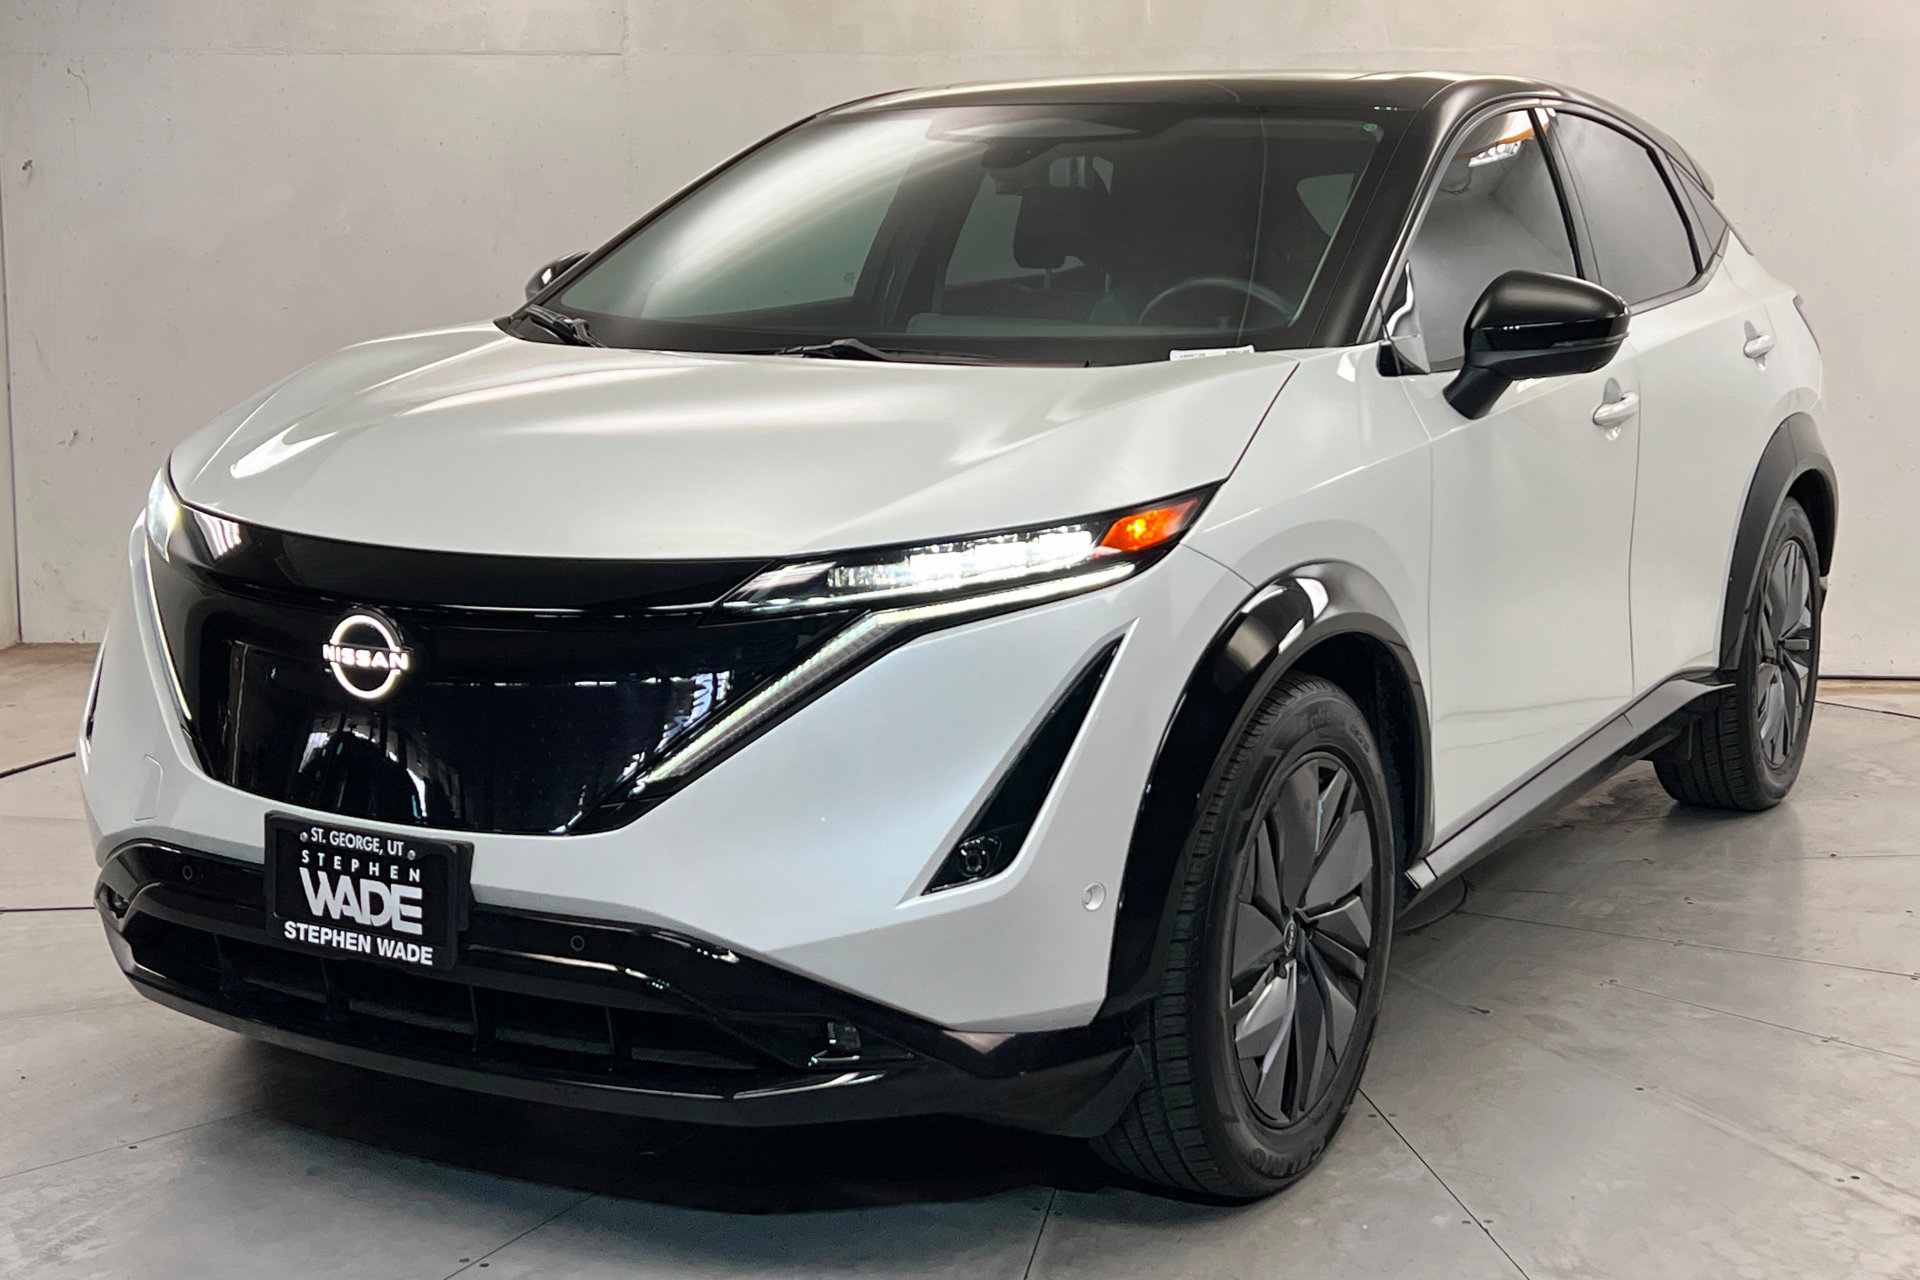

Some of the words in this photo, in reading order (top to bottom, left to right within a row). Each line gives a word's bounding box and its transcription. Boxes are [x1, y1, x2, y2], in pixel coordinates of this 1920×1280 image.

[322, 643, 409, 670] NISSAN
[311, 827, 326, 844] ST.
[330, 831, 384, 855] GEORGE,
[387, 839, 404, 856] UT
[302, 849, 420, 882] STEPHEN
[299, 867, 423, 935] WADE
[284, 921, 371, 953] STEPHEN
[377, 937, 433, 965] WADE
